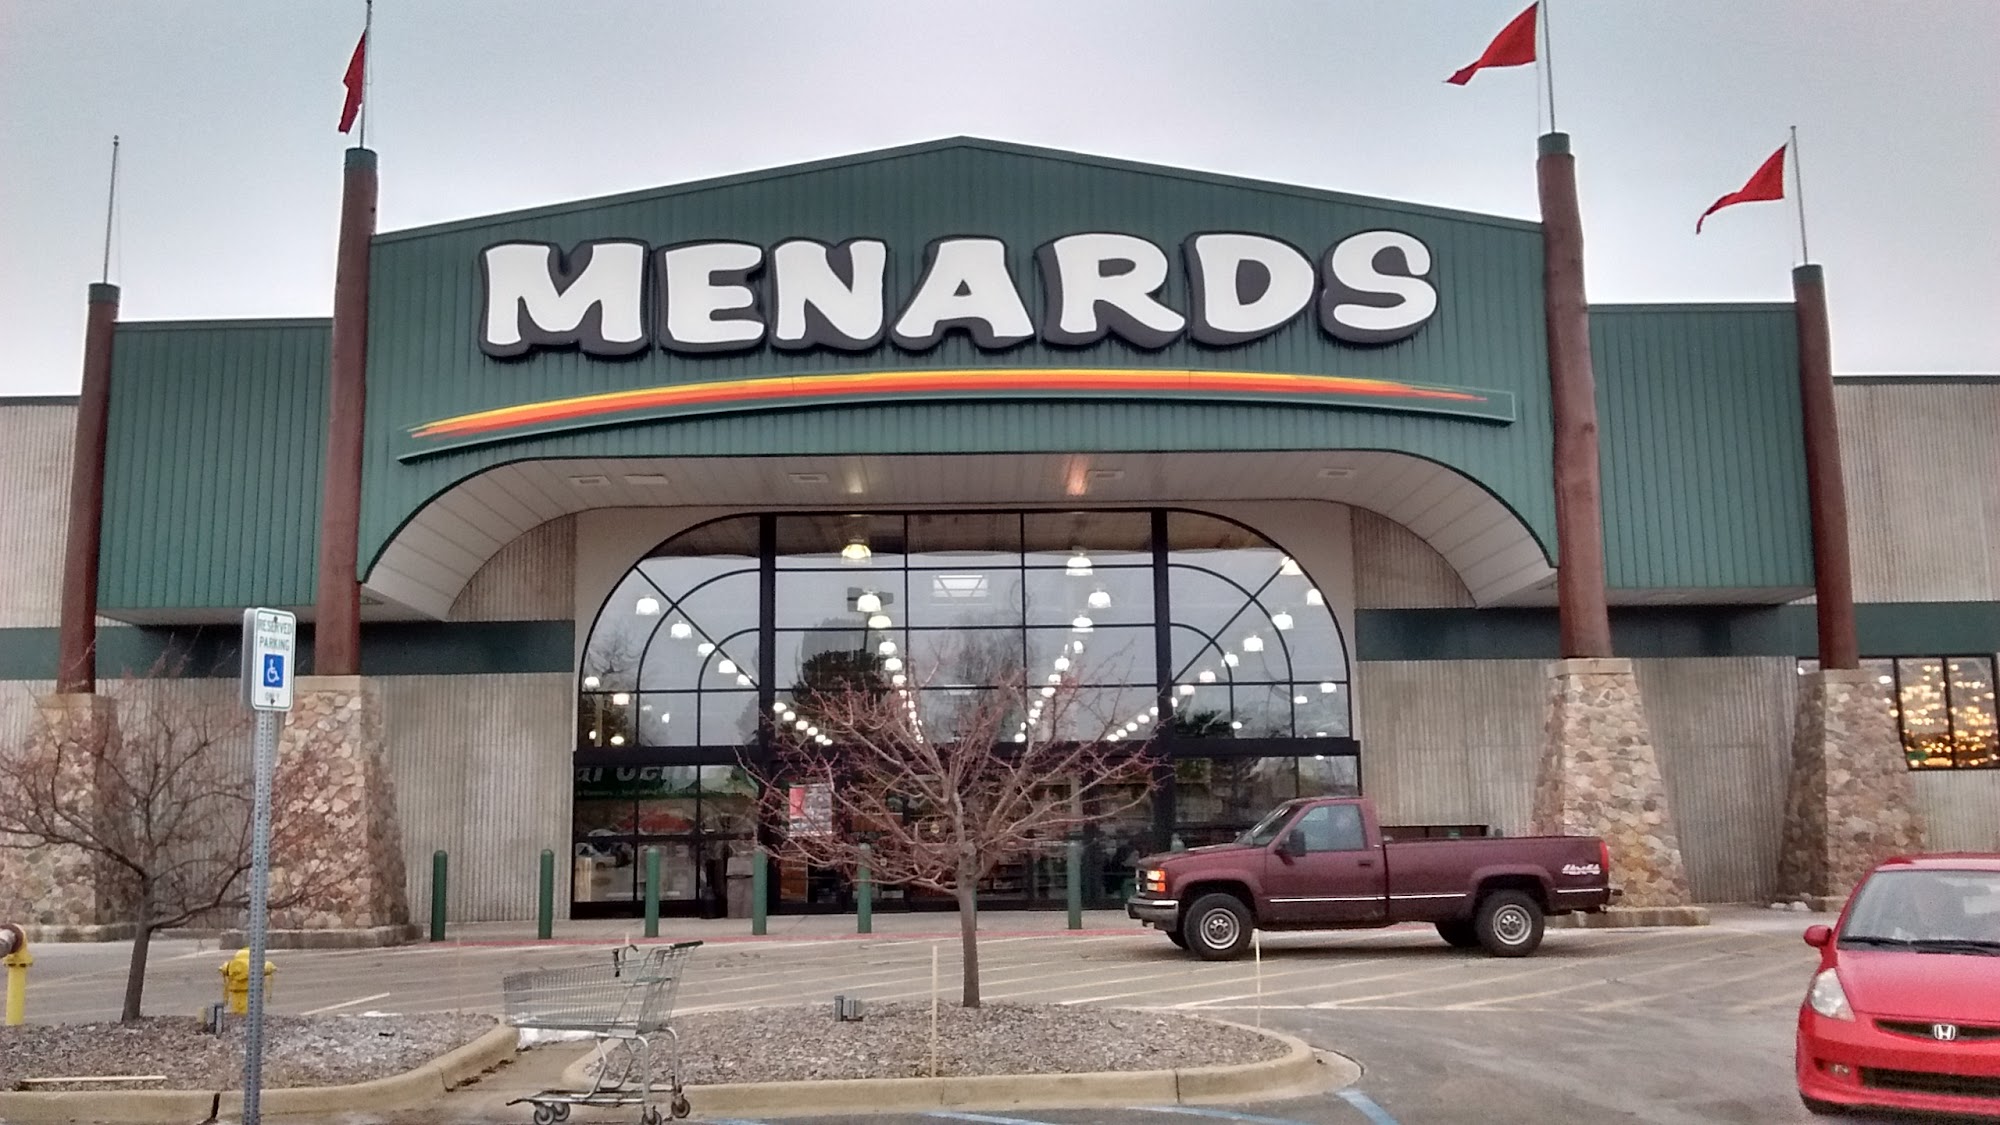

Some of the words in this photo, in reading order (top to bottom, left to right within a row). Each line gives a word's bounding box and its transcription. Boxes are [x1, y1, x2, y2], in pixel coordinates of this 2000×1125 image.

[481, 228, 1440, 358] MENARDS
[257, 619, 293, 635] RESERVED
[259, 636, 290, 651] PARKING
